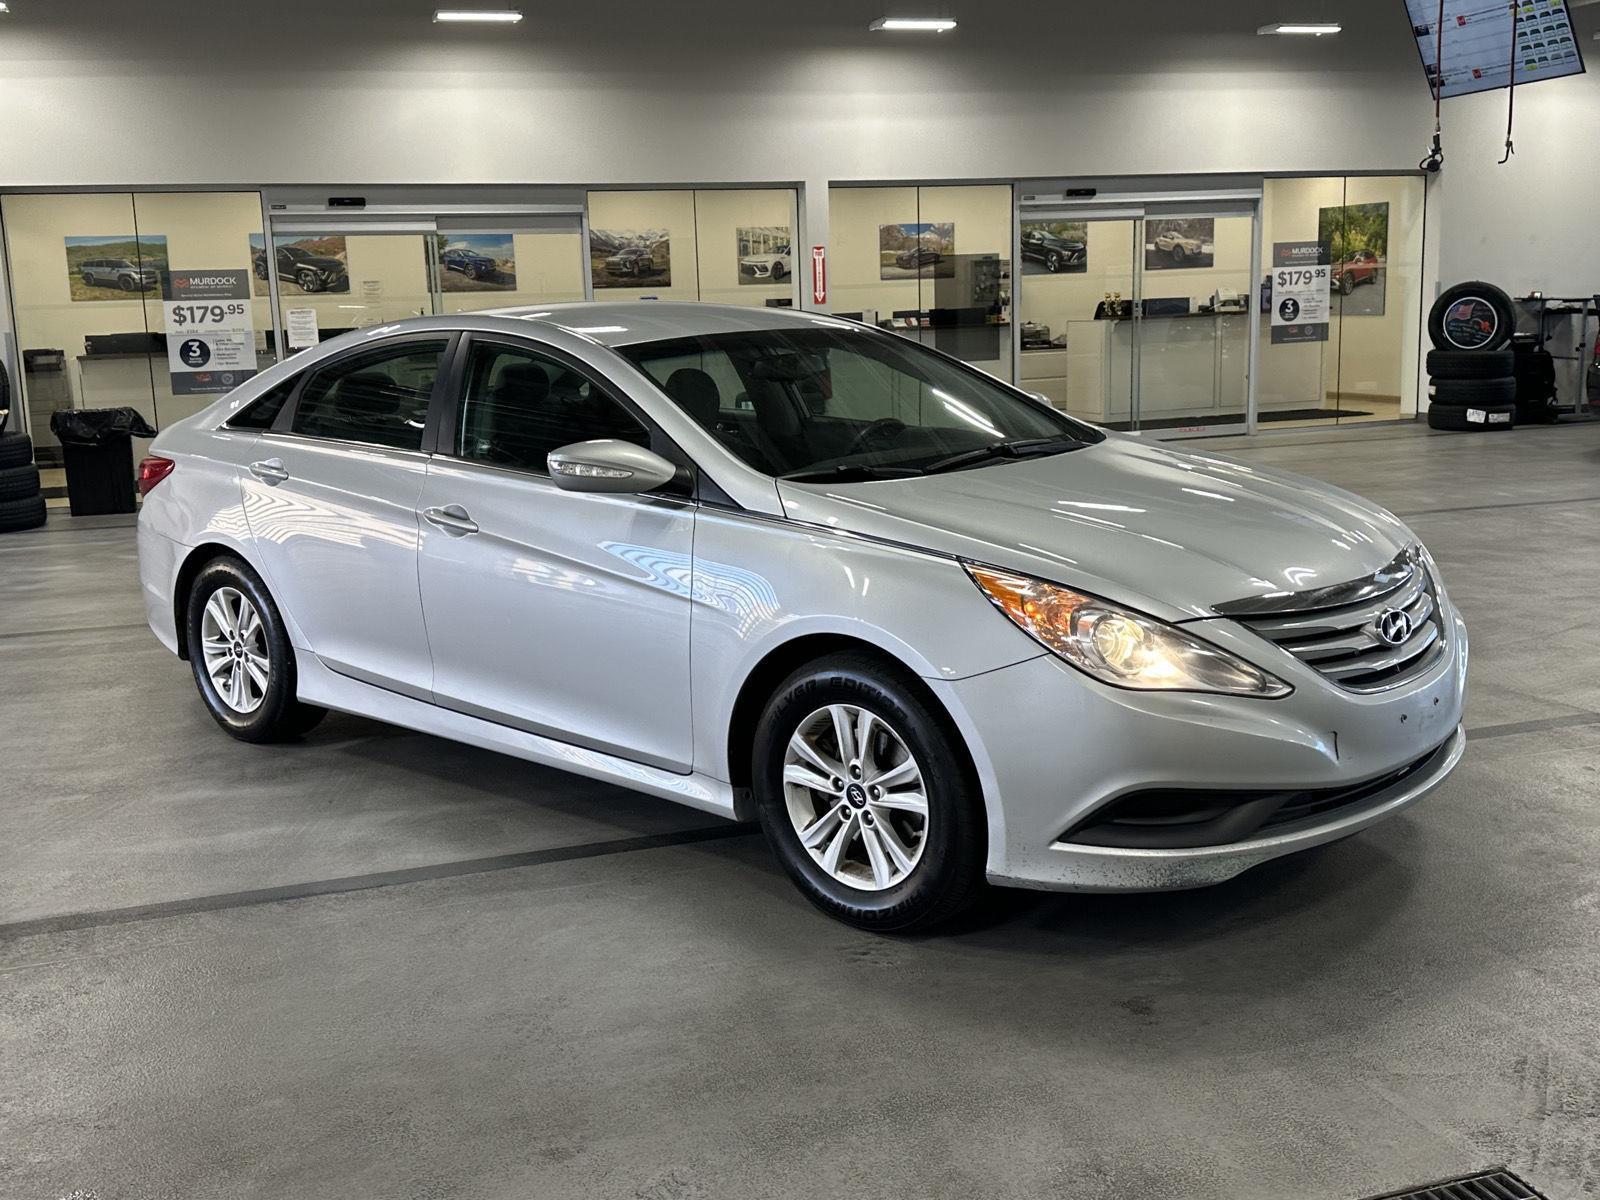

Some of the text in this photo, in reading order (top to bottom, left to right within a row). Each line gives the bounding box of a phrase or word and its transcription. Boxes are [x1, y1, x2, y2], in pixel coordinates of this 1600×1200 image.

[189, 277, 237, 285] MURDOCK
[1285, 300, 1294, 313] 3
[172, 304, 244, 326] $179.95
[188, 341, 201, 357] 3
[830, 676, 909, 719] EDITION
